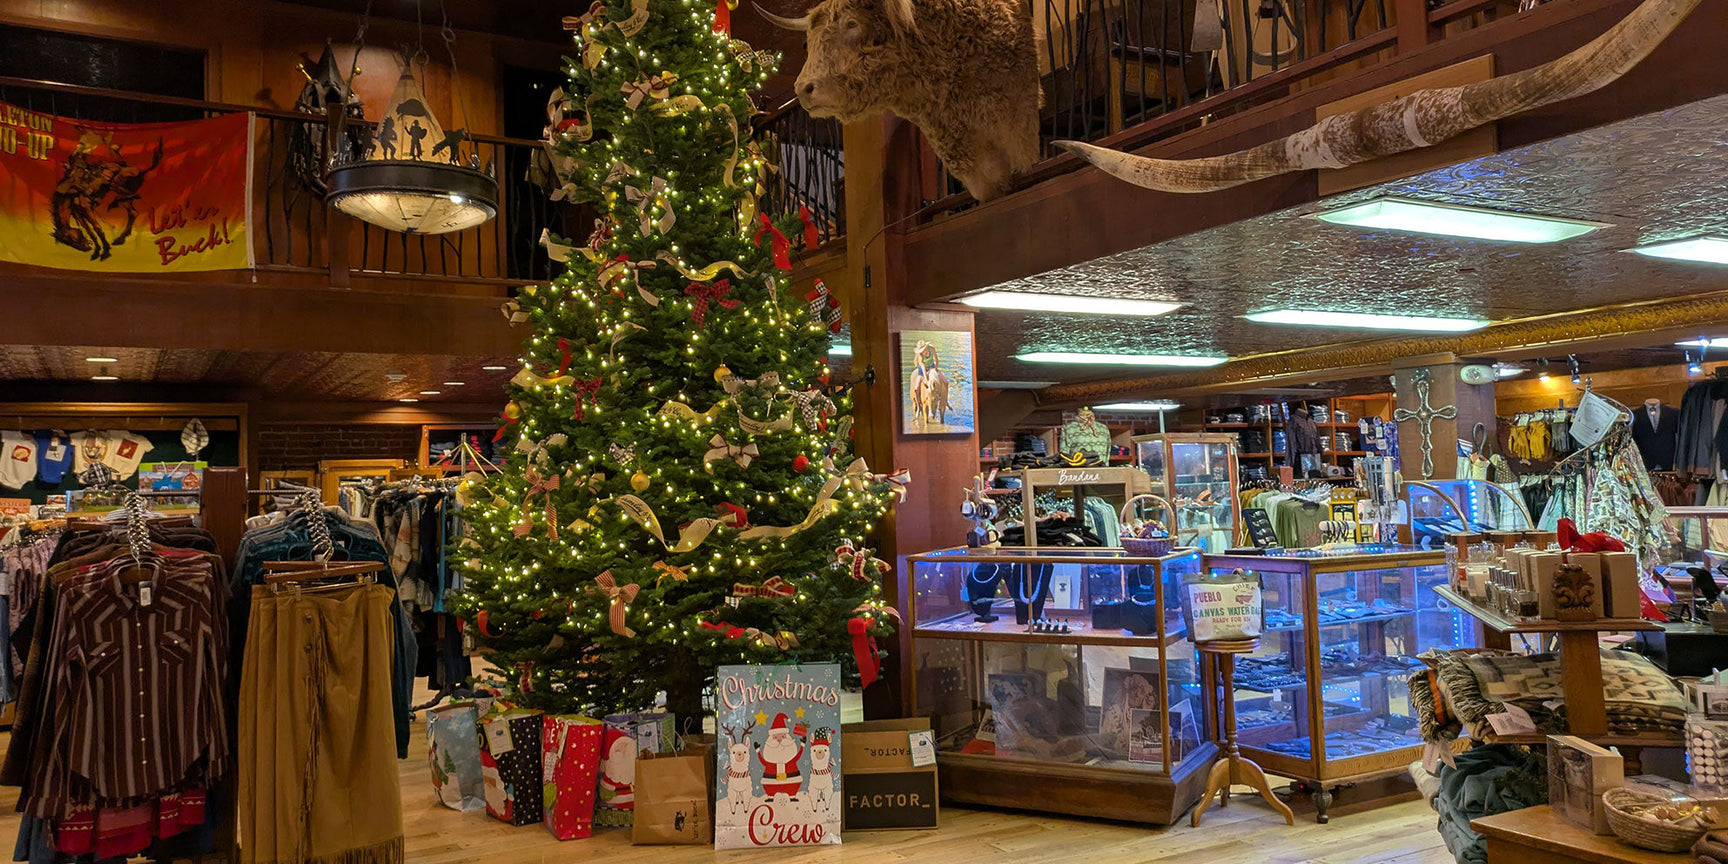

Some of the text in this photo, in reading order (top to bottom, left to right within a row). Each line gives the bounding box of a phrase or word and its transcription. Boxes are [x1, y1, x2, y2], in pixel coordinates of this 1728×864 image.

[154, 216, 231, 266] Buck!
[1058, 469, 1101, 486] Bandana
[1193, 591, 1222, 604] PUEBLO
[1193, 607, 1225, 618] CANVAS
[1227, 606, 1250, 616] WATER
[721, 674, 840, 711] Christmas
[748, 804, 827, 846] Crew
